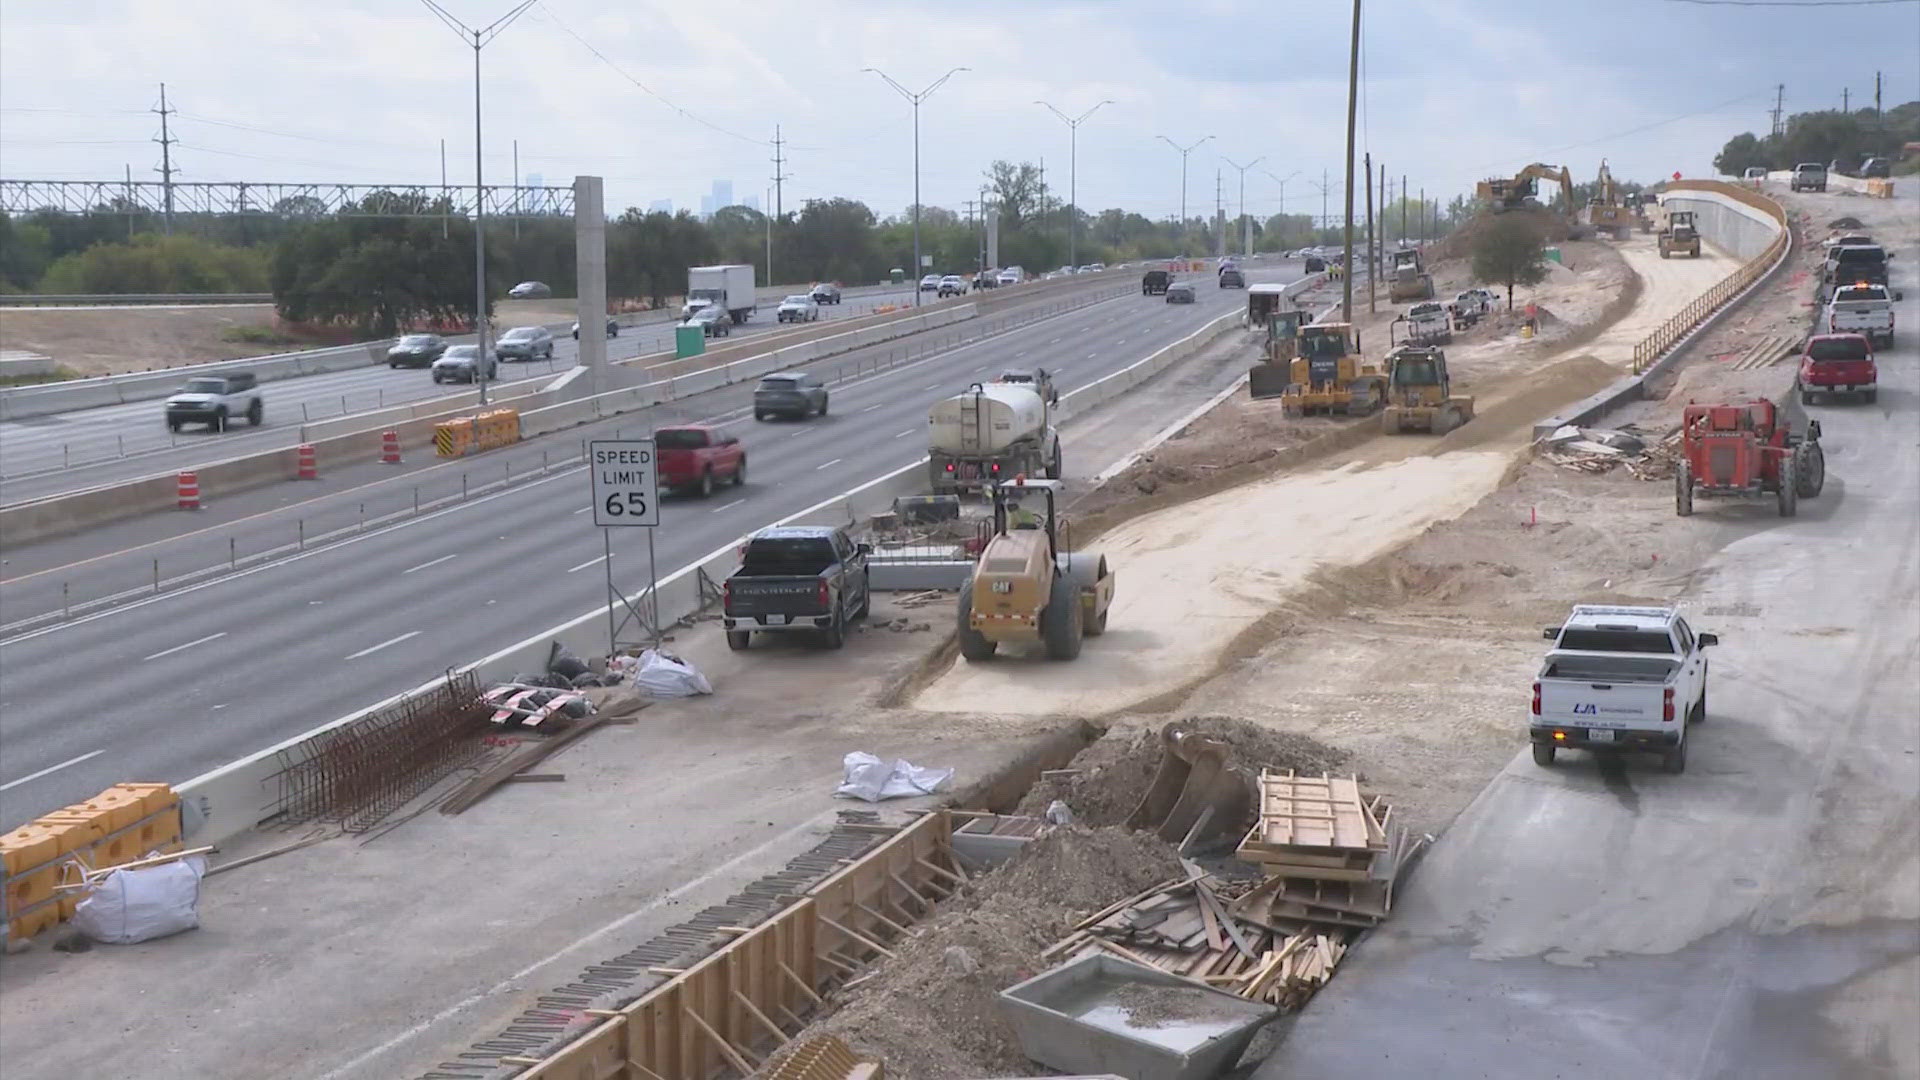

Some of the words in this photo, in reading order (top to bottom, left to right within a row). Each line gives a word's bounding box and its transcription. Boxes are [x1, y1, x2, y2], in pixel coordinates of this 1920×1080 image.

[596, 450, 650, 464] SPEED
[603, 471, 645, 485] LIMIT
[606, 492, 646, 517] 65
[735, 587, 812, 595] CHEVROLET
[992, 581, 1010, 593] CAT
[1573, 703, 1597, 715] LJA
